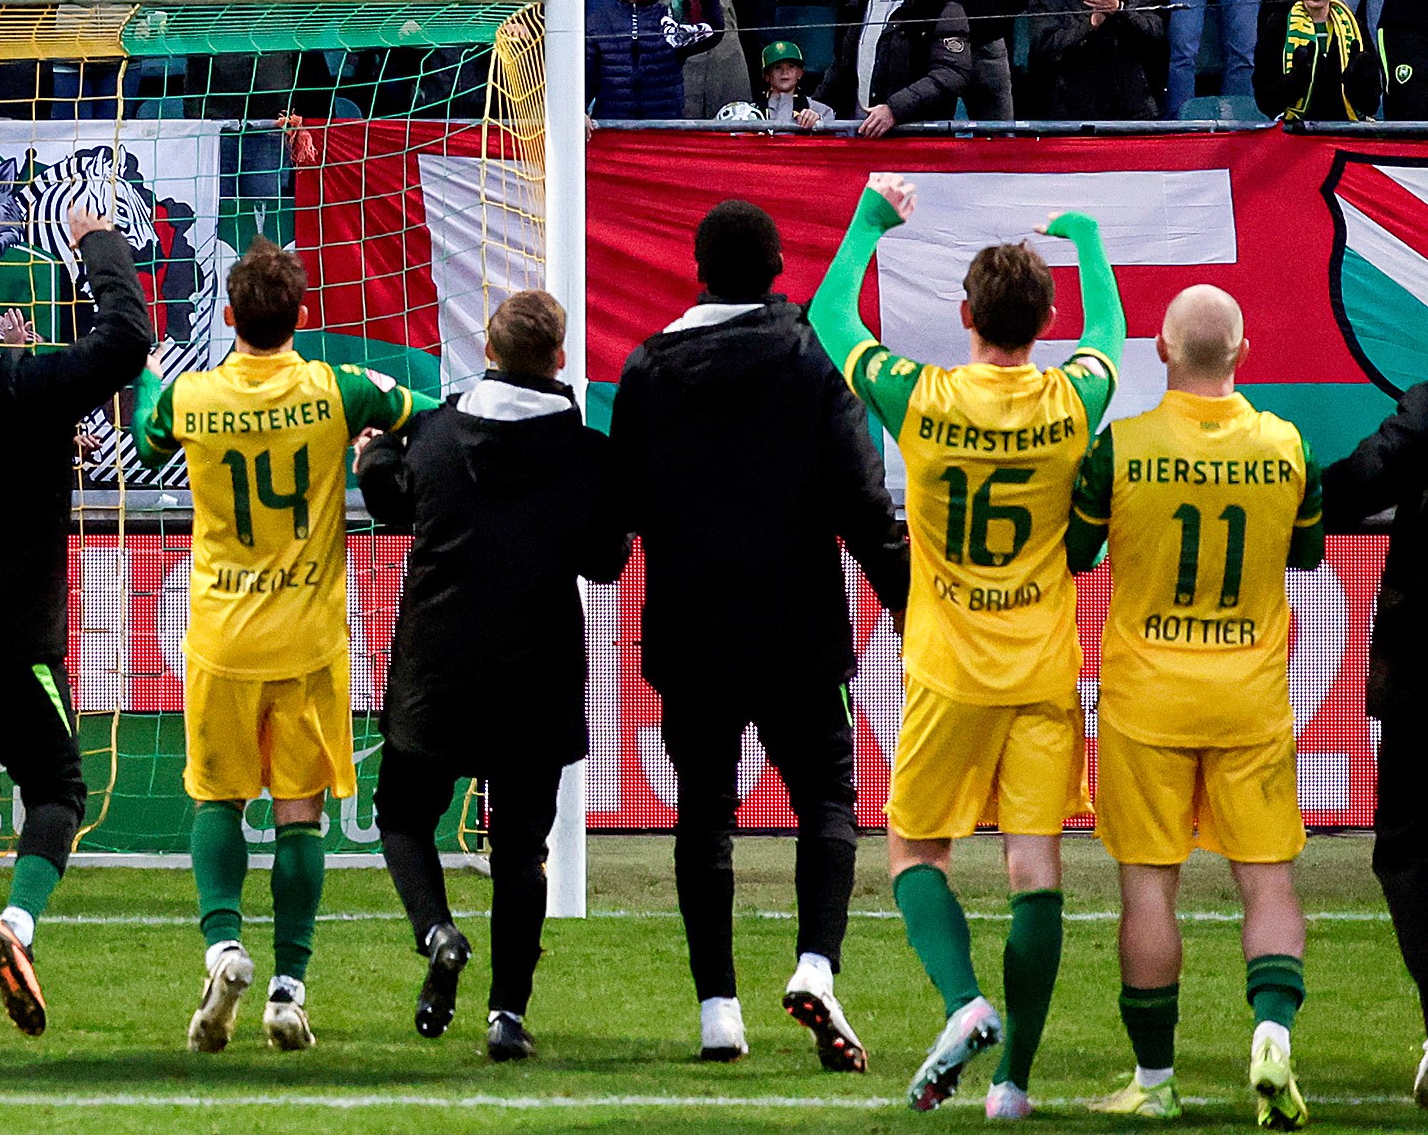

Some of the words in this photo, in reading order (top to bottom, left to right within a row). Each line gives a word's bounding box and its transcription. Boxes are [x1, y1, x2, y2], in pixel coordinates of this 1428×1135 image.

[186, 399, 332, 434] BIERSTEKER
[919, 415, 1075, 452] BIERSTEKER
[1127, 457, 1293, 485] BIERSTEKER
[221, 442, 311, 548] 14
[939, 465, 1037, 567] 16
[1172, 502, 1247, 609] 11
[934, 575, 961, 604] DE
[1144, 614, 1256, 646] ROTTIER
